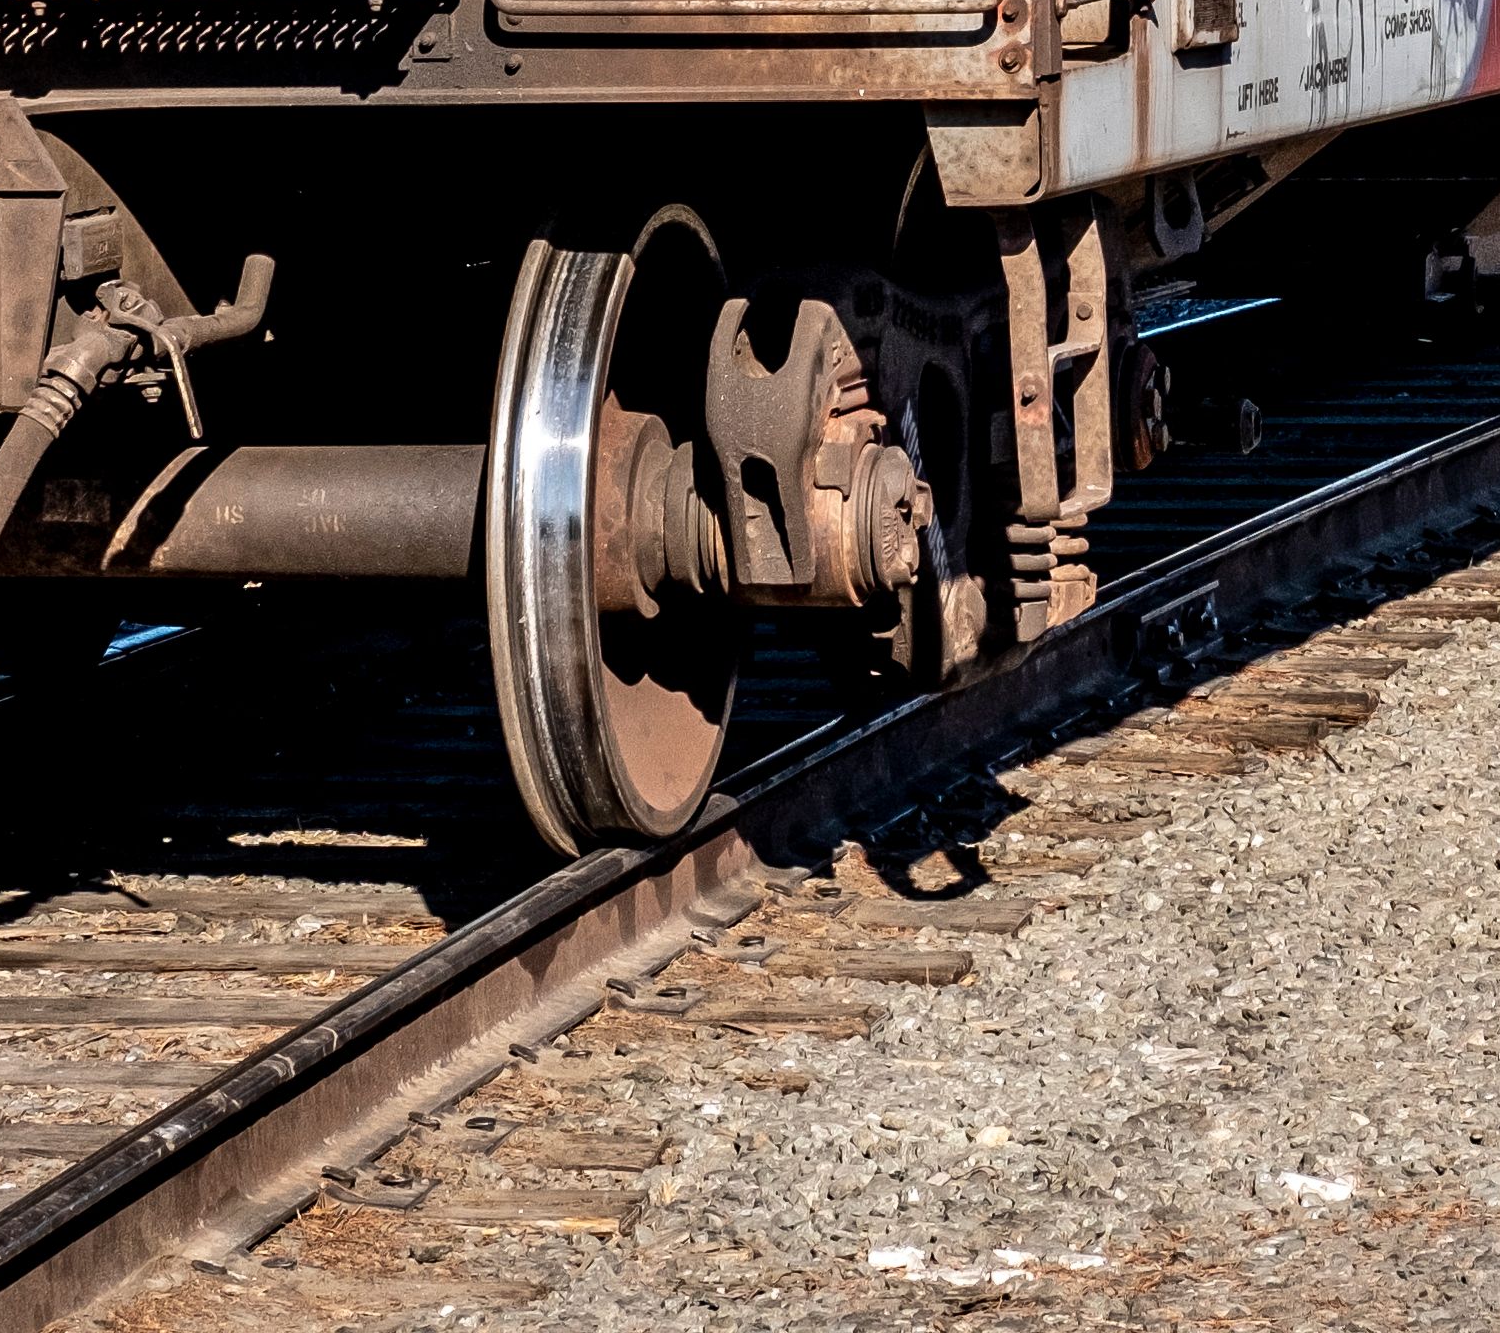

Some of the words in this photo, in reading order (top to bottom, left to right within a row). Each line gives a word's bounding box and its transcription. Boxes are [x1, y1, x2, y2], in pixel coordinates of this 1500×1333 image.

[1385, 14, 1407, 40] COMP
[1409, 9, 1432, 35] SHOES
[1329, 56, 1349, 85] HERE
[1238, 83, 1253, 111] LIFT
[1258, 77, 1279, 106] HERE
